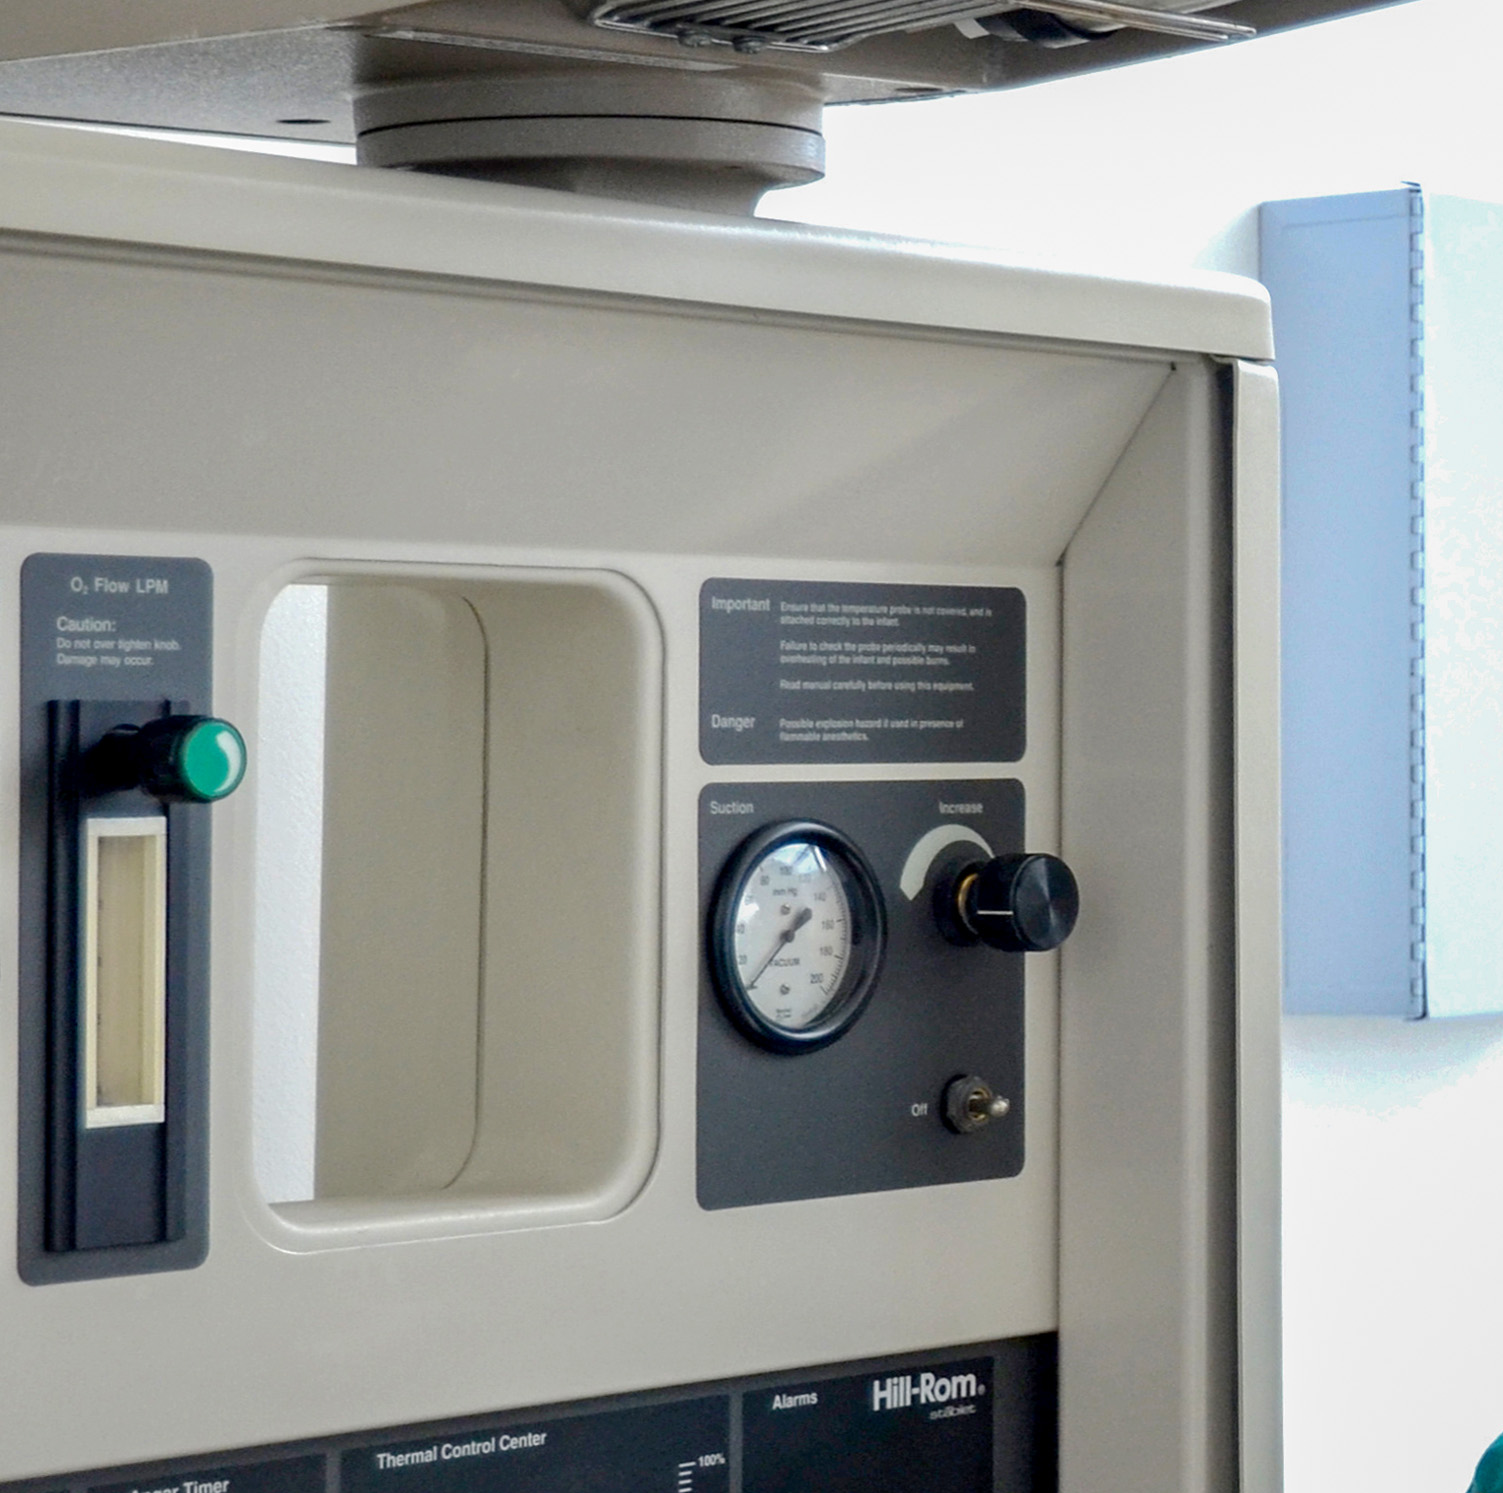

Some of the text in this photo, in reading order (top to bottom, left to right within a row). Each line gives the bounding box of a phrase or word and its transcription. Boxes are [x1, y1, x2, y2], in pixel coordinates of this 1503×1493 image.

[94, 577, 130, 593] Flow
[136, 578, 169, 594] LPM
[711, 596, 771, 614] Important
[57, 616, 116, 632] Caution:
[57, 637, 72, 649] Do
[711, 713, 756, 732] Danger
[710, 801, 755, 815] Suction
[939, 801, 984, 815] Increase
[911, 1103, 929, 1117] Off
[873, 1372, 977, 1412] Hill-Rom
[772, 1391, 818, 1410] Alarms
[377, 1432, 547, 1470] Thermal Control Center
[698, 1452, 726, 1468] 100%
